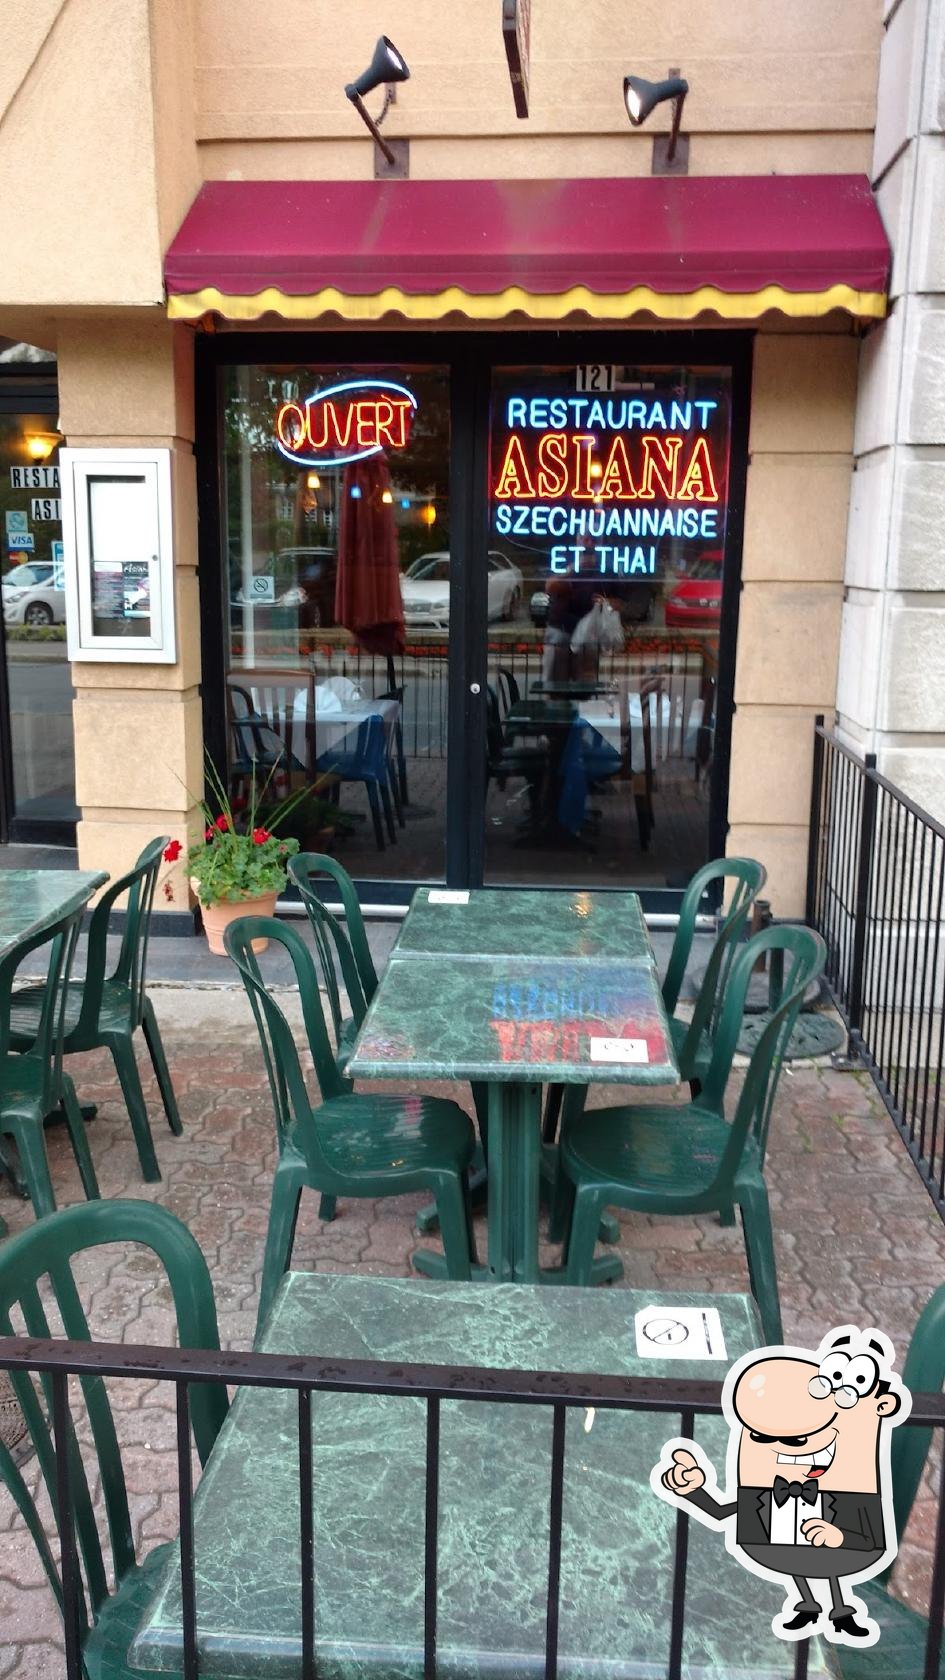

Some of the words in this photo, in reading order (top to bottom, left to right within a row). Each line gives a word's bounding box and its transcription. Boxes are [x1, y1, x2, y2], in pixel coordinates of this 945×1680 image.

[578, 365, 615, 391] 121
[277, 394, 412, 450] OUVERT
[507, 398, 718, 430] RESTAURANT
[12, 467, 60, 488] RESTA
[495, 433, 719, 502] ASIANA
[495, 504, 718, 538] SZECHUANNAISE
[11, 535, 33, 545] VISA
[550, 546, 586, 574] ET
[594, 546, 656, 574] THAI
